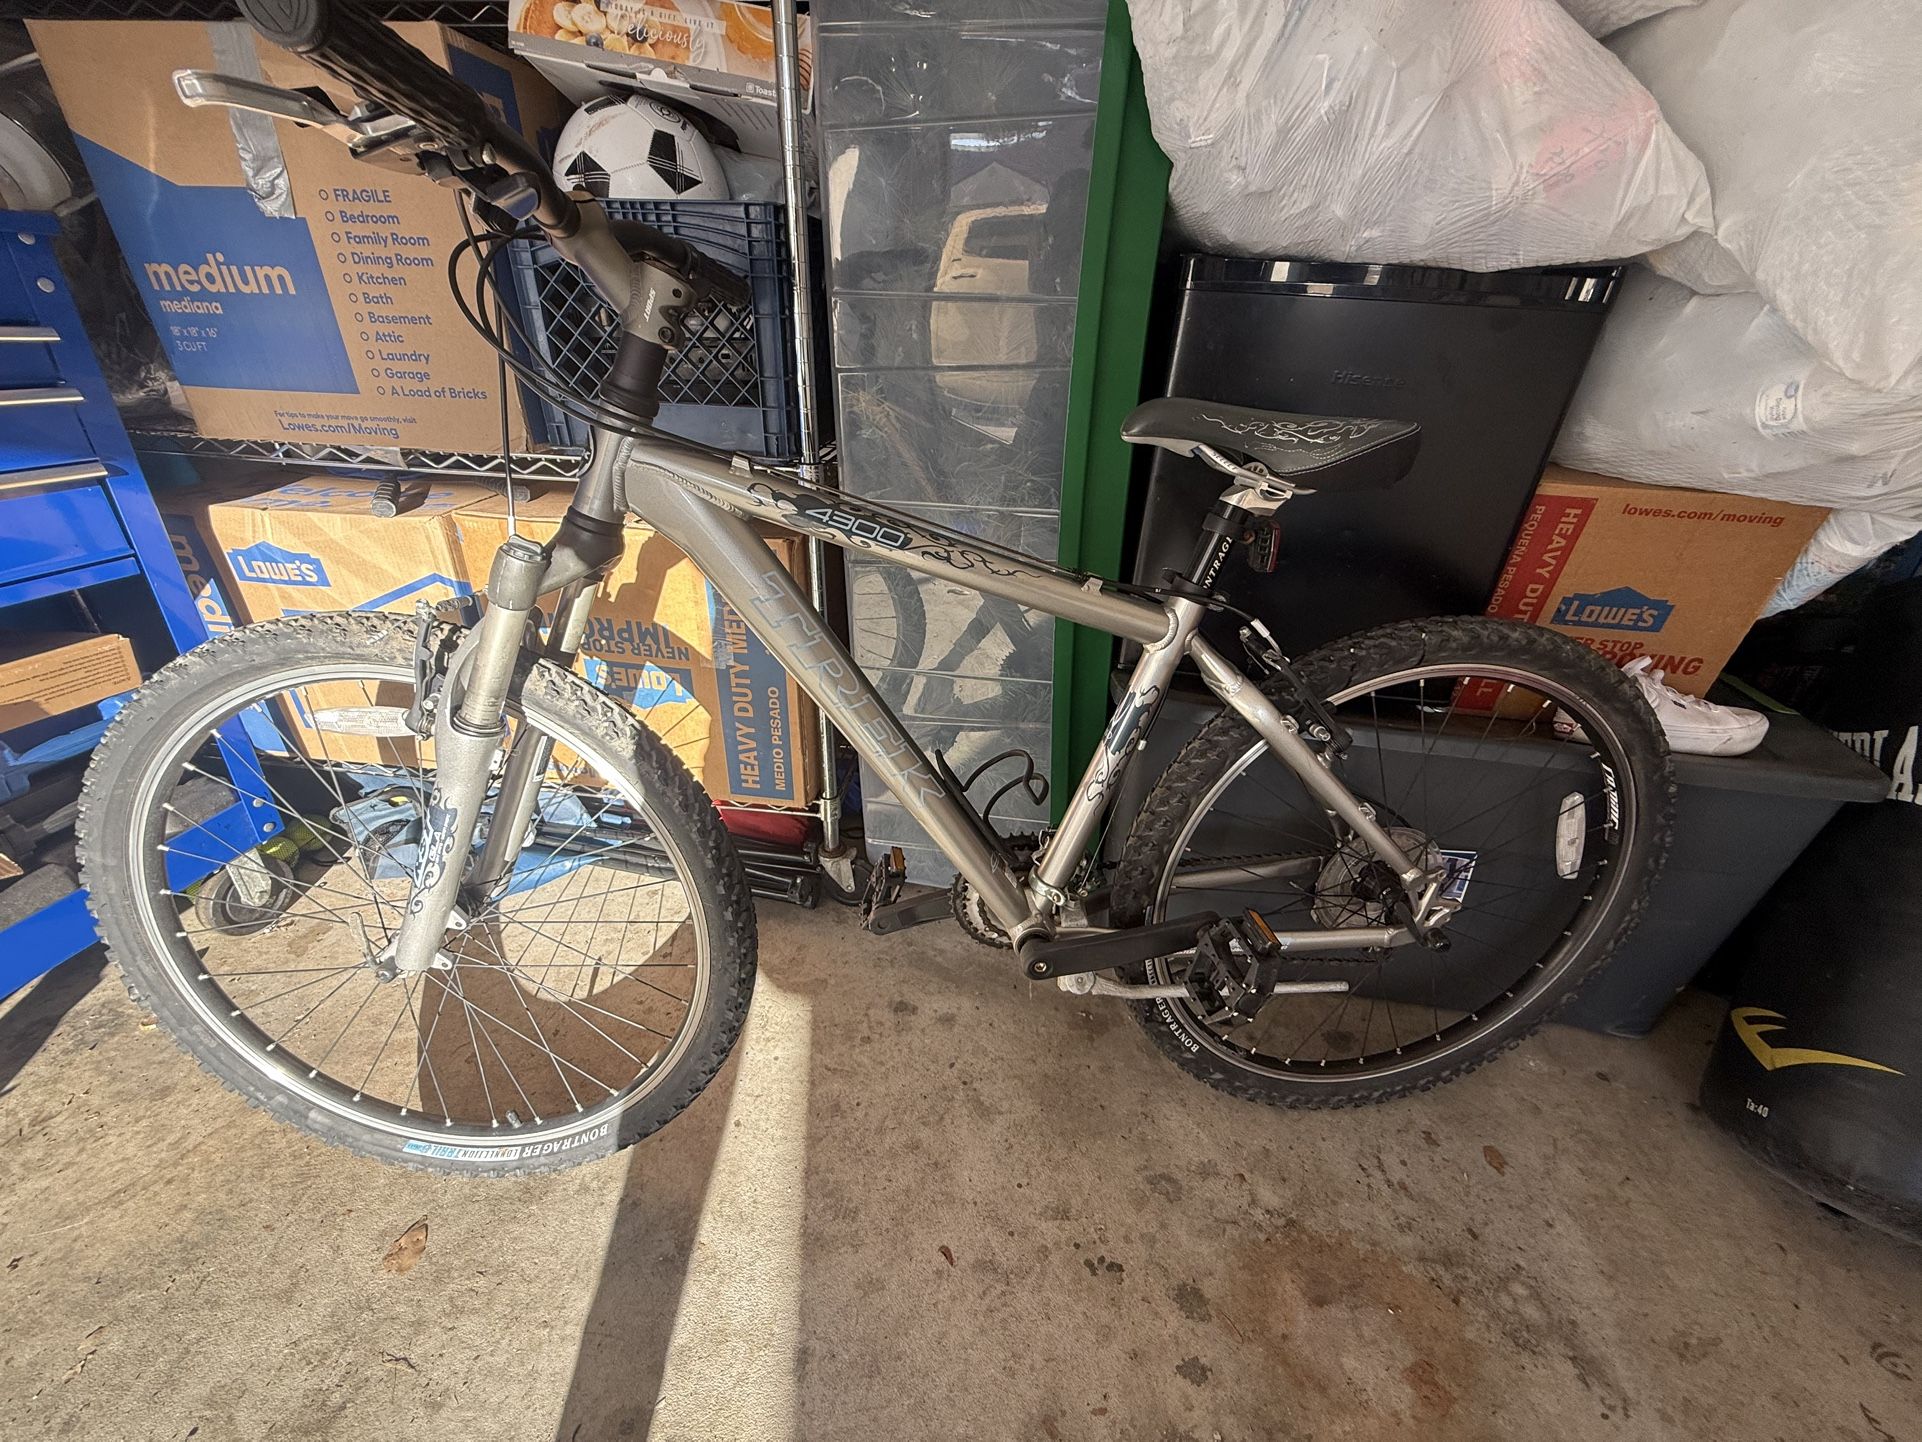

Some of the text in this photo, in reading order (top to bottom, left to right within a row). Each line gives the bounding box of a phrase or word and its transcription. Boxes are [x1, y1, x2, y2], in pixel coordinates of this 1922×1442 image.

[754, 84, 777, 97] Toast
[333, 188, 392, 204] FRAGILE
[339, 210, 400, 225] Bedroom
[345, 231, 430, 248] Family Room
[351, 252, 434, 269] Dining Room
[144, 252, 296, 295] medium
[356, 272, 407, 286] Kitchen
[160, 296, 224, 315] mediana
[362, 292, 394, 306] Bath
[368, 312, 433, 326] Basement
[375, 331, 404, 344] Attic
[378, 349, 430, 365] Laundry
[384, 368, 431, 382] Garage
[391, 386, 488, 400] A Load of Bricks
[274, 410, 285, 418] For
[307, 412, 324, 420] make
[402, 416, 418, 424] visit
[278, 419, 400, 440] Lowes.com/Moving
[1622, 503, 1786, 528] lowes.com/moving
[805, 508, 906, 547] 4300
[236, 556, 319, 582] LOWE'S
[1488, 505, 1546, 613] PEQUENA PESADO
[1514, 507, 1583, 622] HEAVY DUT
[1565, 600, 1658, 627] LOWE'S
[580, 637, 690, 662] NEVER STOP
[1597, 638, 1645, 652] STOP
[594, 660, 683, 698] LOWE'S
[752, 570, 946, 808] TREK
[729, 663, 755, 719] DUTY
[767, 686, 786, 791] MEDIO PESADO
[736, 722, 761, 790] HEAVY
[1155, 996, 1201, 1054] BONTRAGER
[522, 1122, 610, 1159] BONTRAGER
